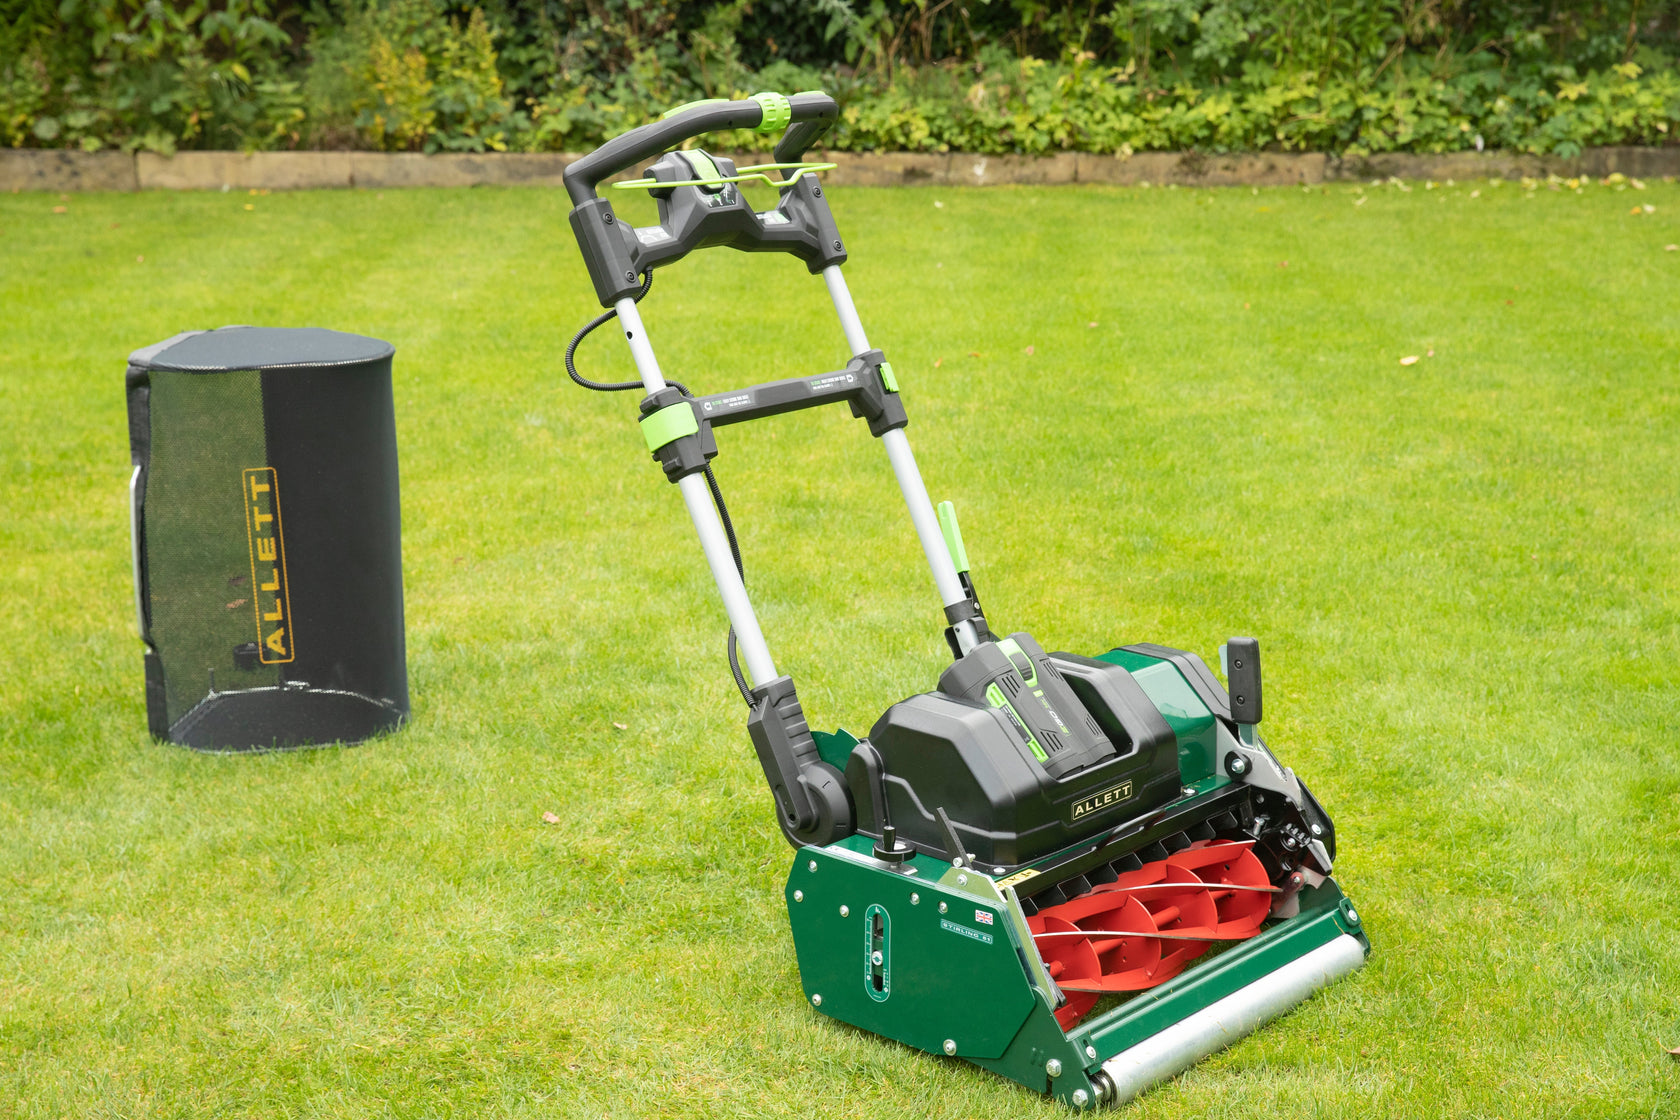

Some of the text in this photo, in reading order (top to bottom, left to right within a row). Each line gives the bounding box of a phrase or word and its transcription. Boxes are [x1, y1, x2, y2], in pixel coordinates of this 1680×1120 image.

[251, 475, 286, 656] ALLETT
[1074, 785, 1130, 816] ALLETT
[943, 922, 979, 938] STIRLING
